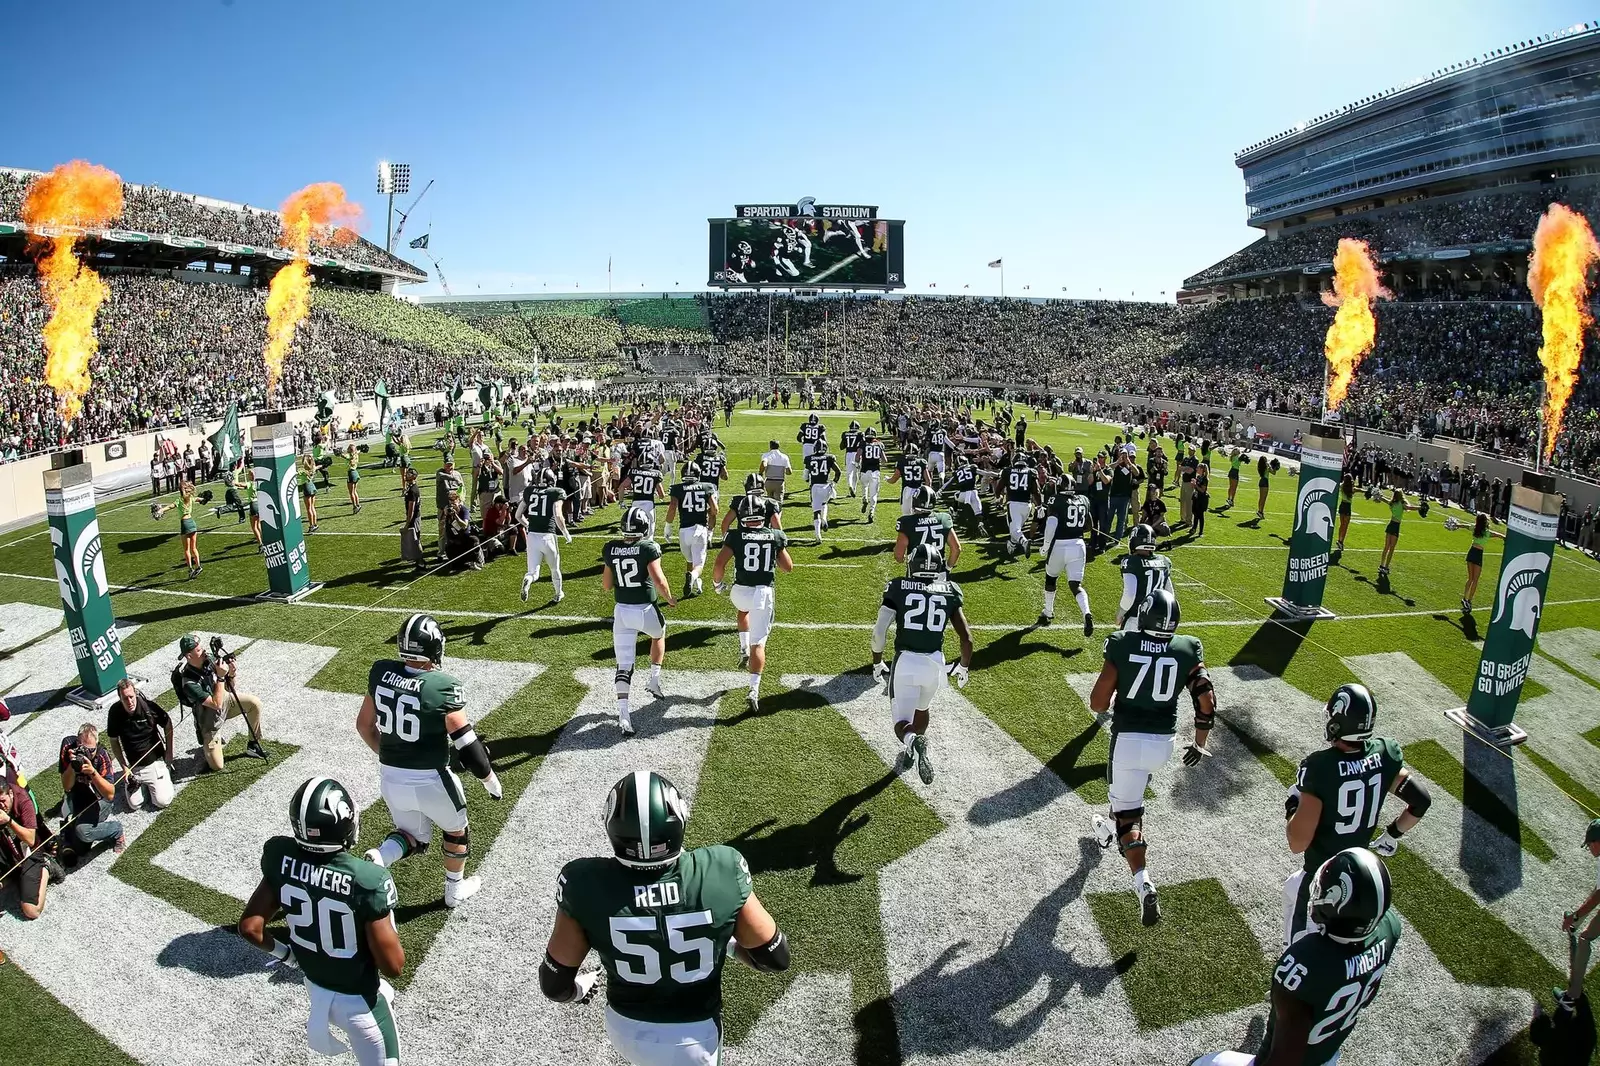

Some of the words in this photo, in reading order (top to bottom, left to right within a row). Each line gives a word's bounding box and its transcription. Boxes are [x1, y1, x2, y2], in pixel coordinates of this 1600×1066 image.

[743, 206, 790, 217] SPARTAN
[822, 206, 870, 218] STADIUM
[662, 432, 669, 444] 6
[805, 428, 819, 440] 99
[845, 436, 857, 448] 17
[931, 433, 944, 445] 48
[865, 445, 880, 459] 80
[702, 460, 720, 477] 35
[810, 460, 828, 476] 34
[903, 465, 922, 481] 53
[957, 467, 973, 483] 25
[633, 476, 654, 494] 20
[1009, 473, 1028, 491] 94
[528, 493, 548, 516] 21
[682, 490, 706, 512] 45
[917, 515, 938, 525] JARVIS
[1066, 505, 1086, 528] 93
[914, 524, 944, 551] 75
[288, 548, 299, 563] GO
[611, 546, 640, 556] LOMBARDI
[743, 542, 772, 572] 81
[1289, 558, 1299, 570] GO
[1300, 552, 1329, 570] GREEN
[291, 560, 302, 574] GO
[612, 558, 642, 588] 12
[1289, 569, 1298, 582] GO
[1299, 565, 1327, 582] WHITE
[1145, 569, 1165, 596] 14
[903, 593, 947, 632] 26
[91, 636, 108, 656] GO
[1141, 640, 1168, 653] HIGBY
[97, 650, 114, 670] GO
[1481, 659, 1495, 676] GO
[1498, 653, 1529, 680] GREEN
[381, 670, 423, 692] CARRICK
[1126, 653, 1178, 702] 70
[1478, 677, 1492, 694] GO
[1495, 671, 1525, 697] WHITE
[374, 685, 421, 742] 56
[1338, 753, 1382, 777] CAMPER
[1334, 773, 1382, 835] 91
[281, 855, 352, 896] FLOWERS
[384, 879, 398, 906] 2
[633, 881, 680, 908] REID
[280, 883, 358, 959] 20
[608, 909, 715, 985] 55
[1345, 939, 1387, 980] WRIGHT
[1274, 954, 1308, 992] 26
[1307, 963, 1387, 1045] 26
